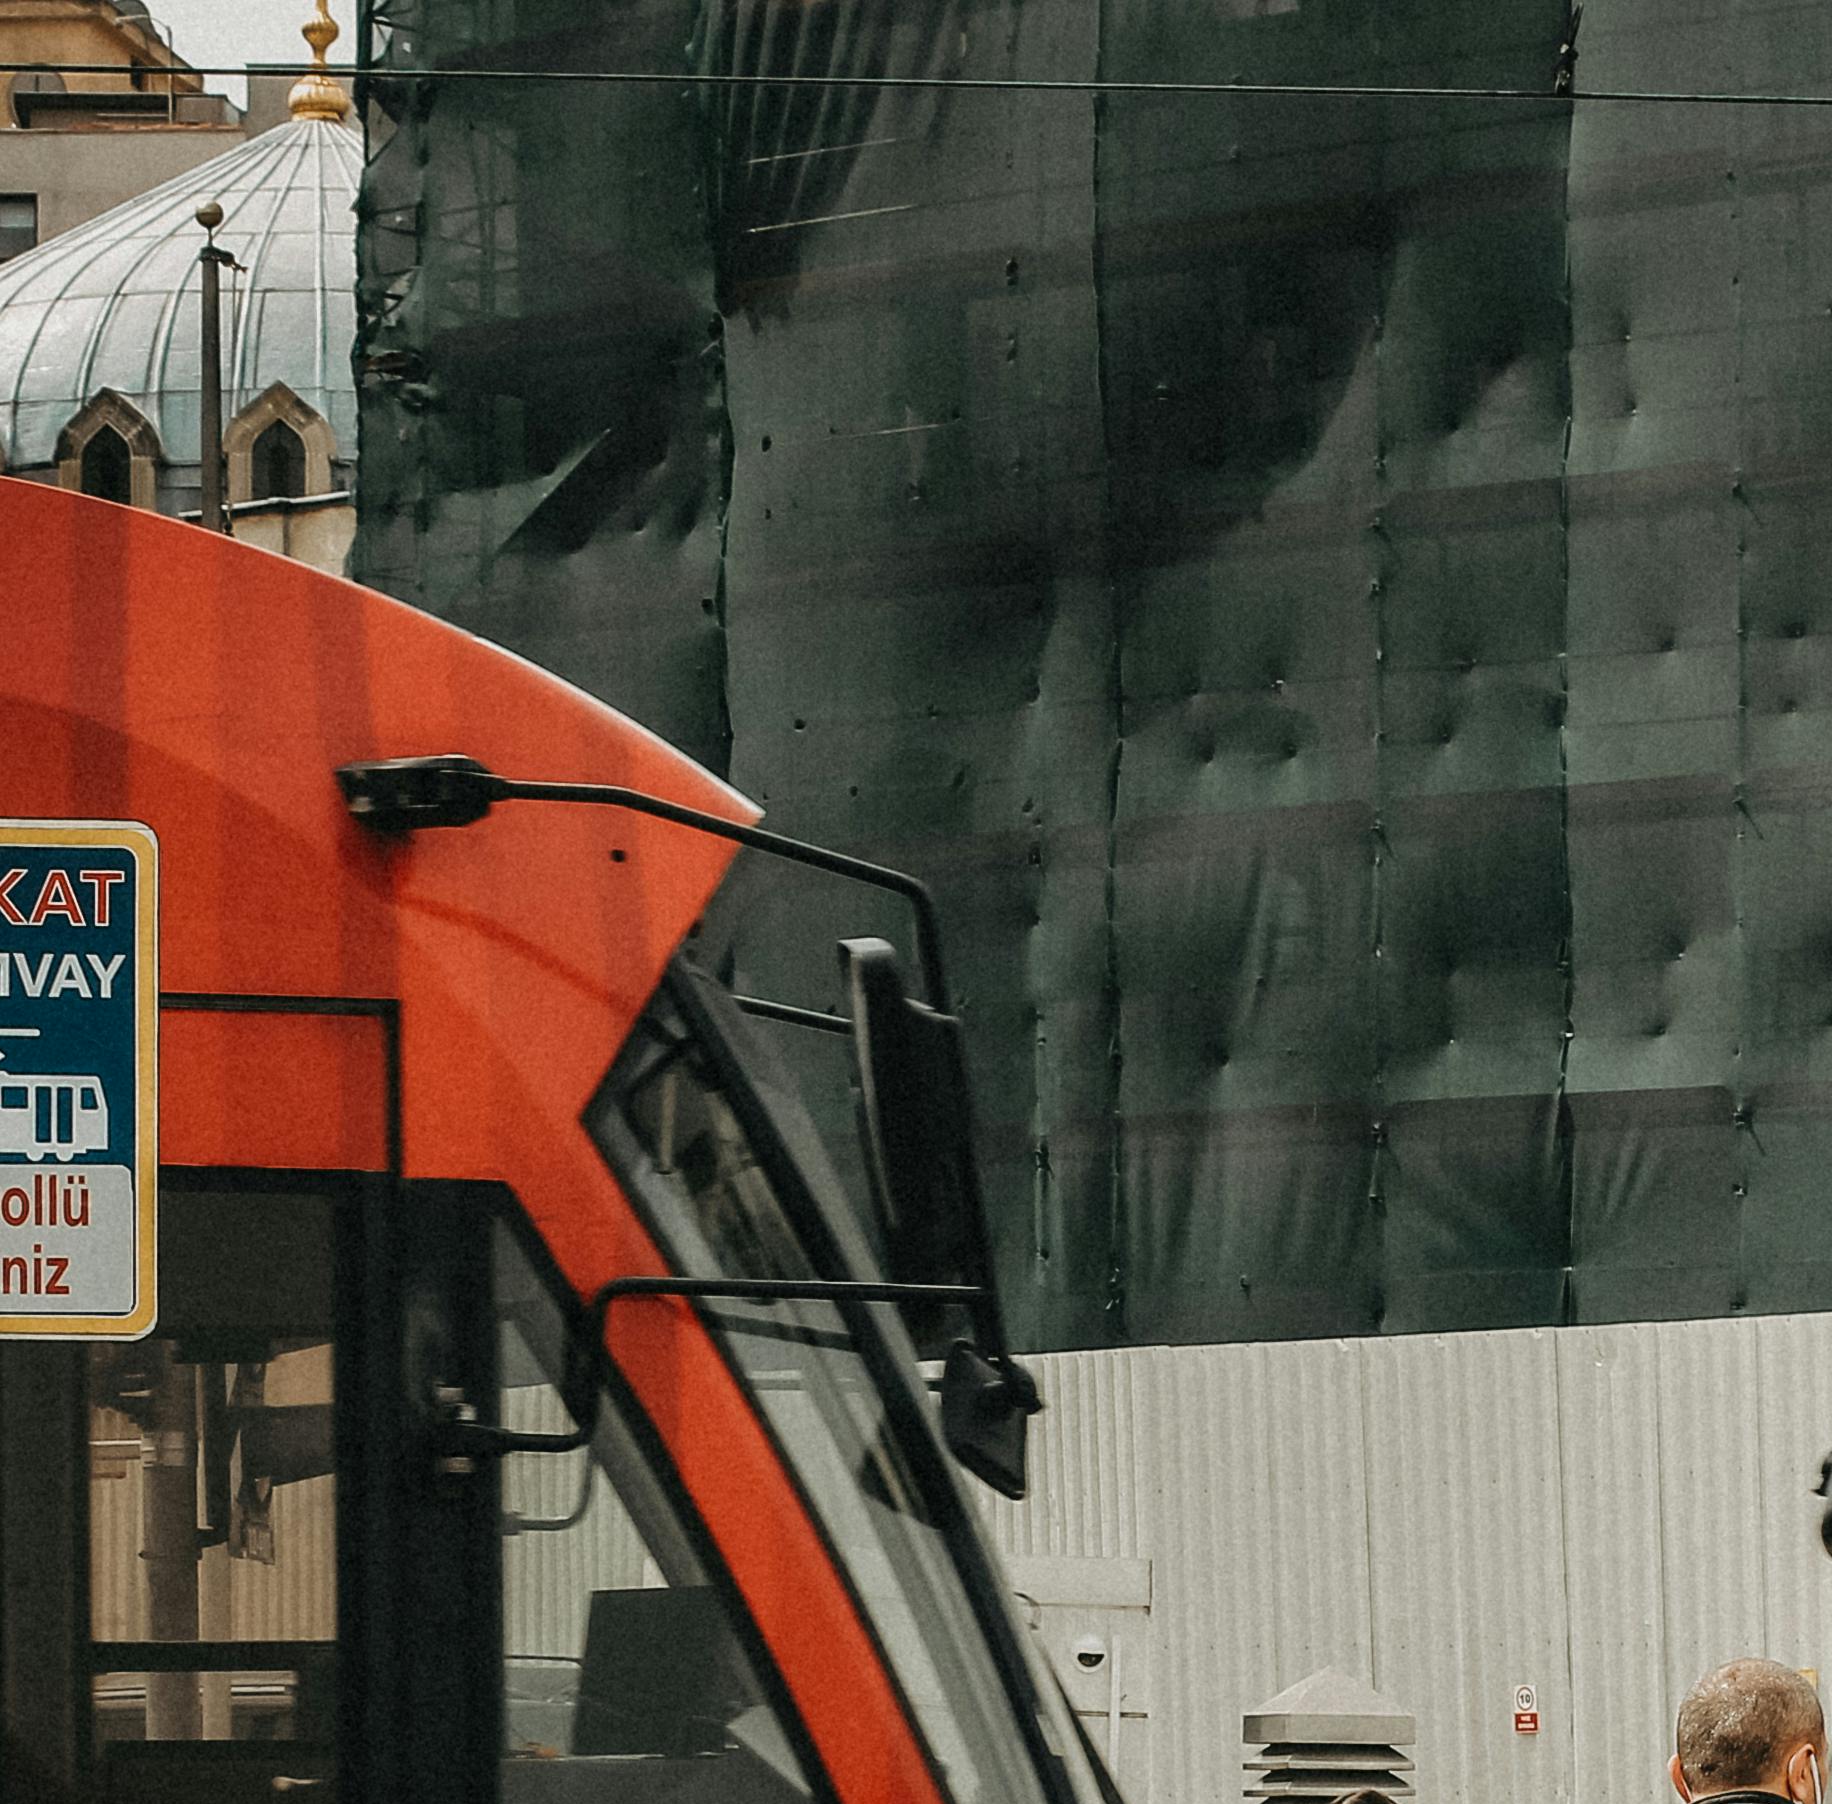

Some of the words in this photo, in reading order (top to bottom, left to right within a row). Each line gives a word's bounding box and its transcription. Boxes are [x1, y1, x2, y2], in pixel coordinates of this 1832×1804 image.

[0, 952, 127, 999] VAY
[1, 1173, 90, 1227] ollü
[2, 1243, 70, 1296] niz
[1519, 1693, 1531, 1704] 10
